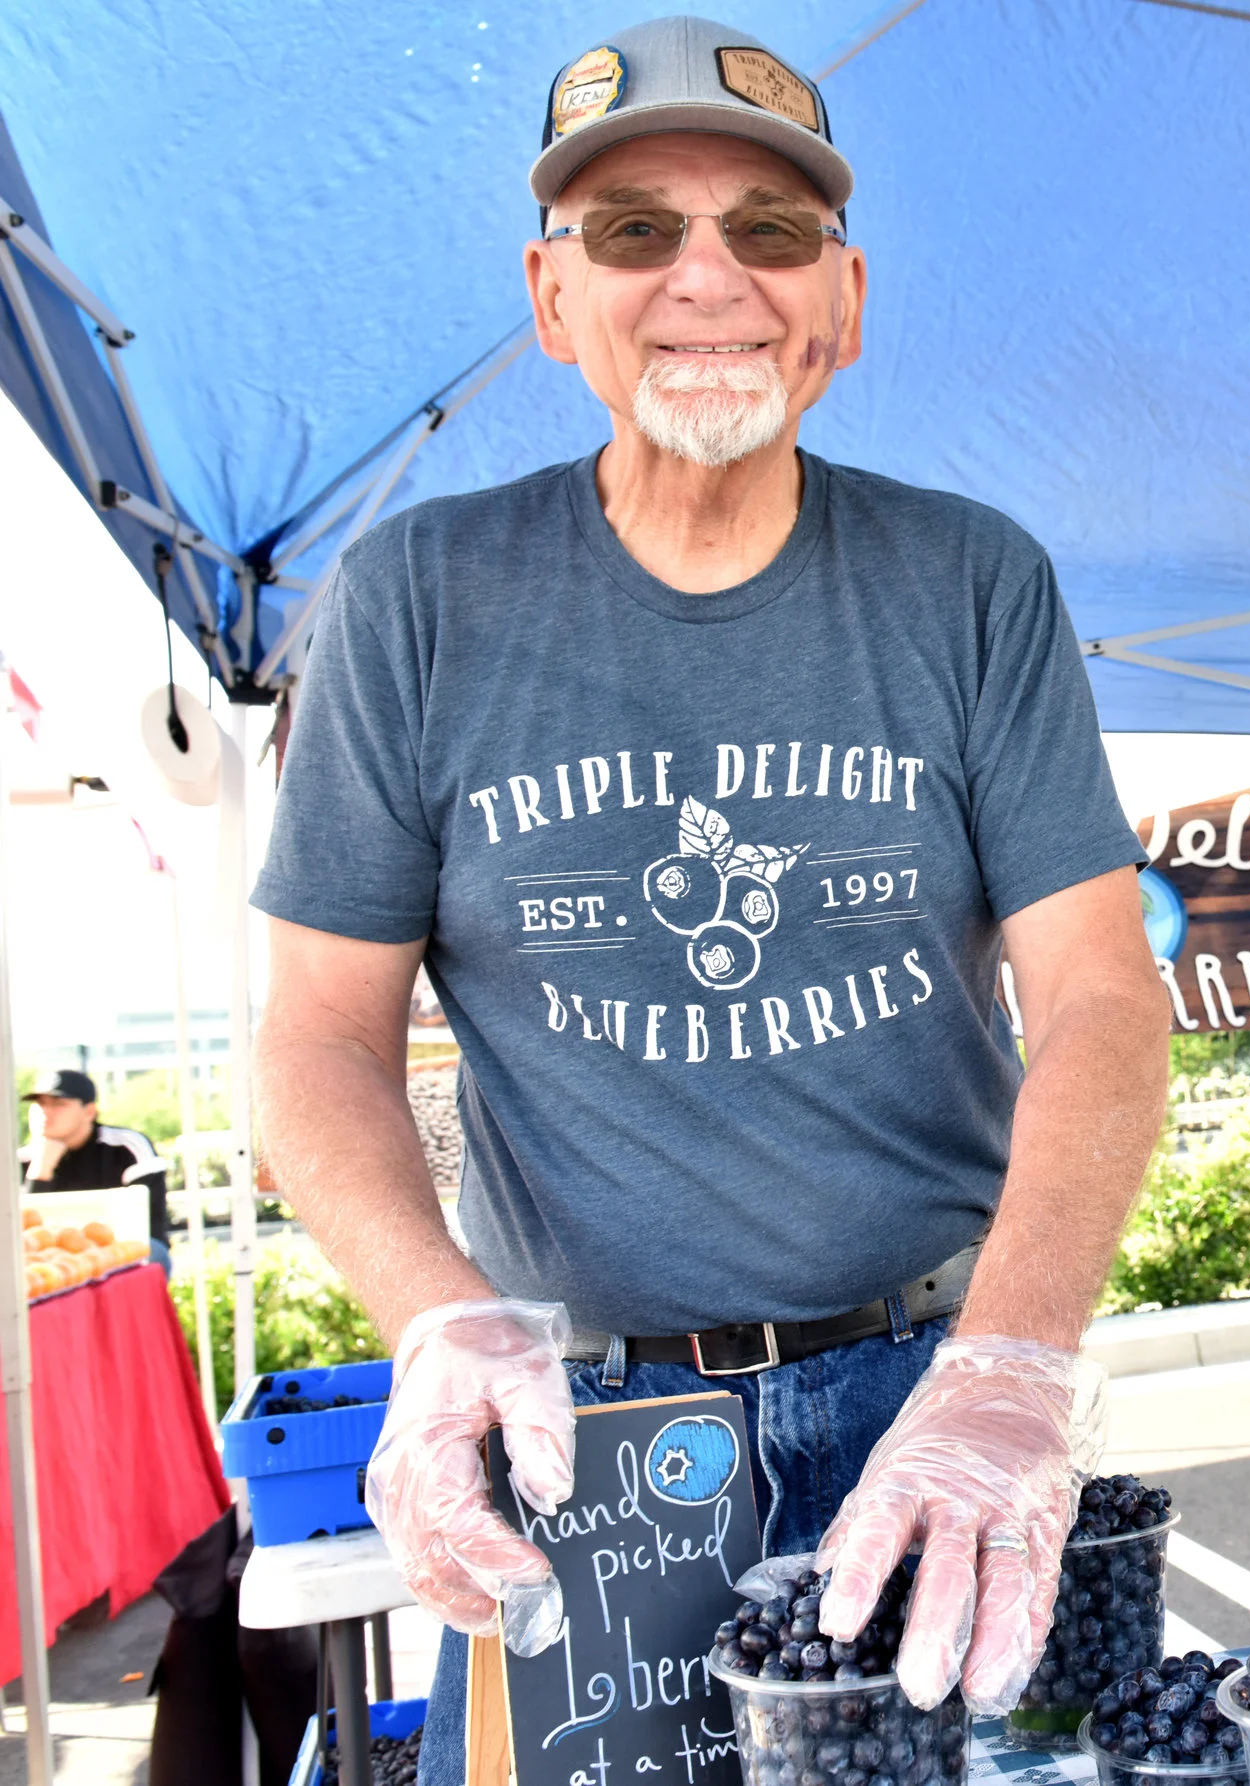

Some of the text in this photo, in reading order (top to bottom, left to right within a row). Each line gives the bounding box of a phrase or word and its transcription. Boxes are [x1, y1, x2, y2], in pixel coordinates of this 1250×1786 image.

[469, 742, 924, 844] TRIPLE DELIGHT
[519, 868, 919, 932] EST. 1997
[541, 948, 933, 1062] BLUEBERRIES
[507, 1441, 655, 1543] hand
[592, 1496, 734, 1633] picked
[624, 1616, 712, 1711] berr
[569, 1725, 740, 1786] at a tim
